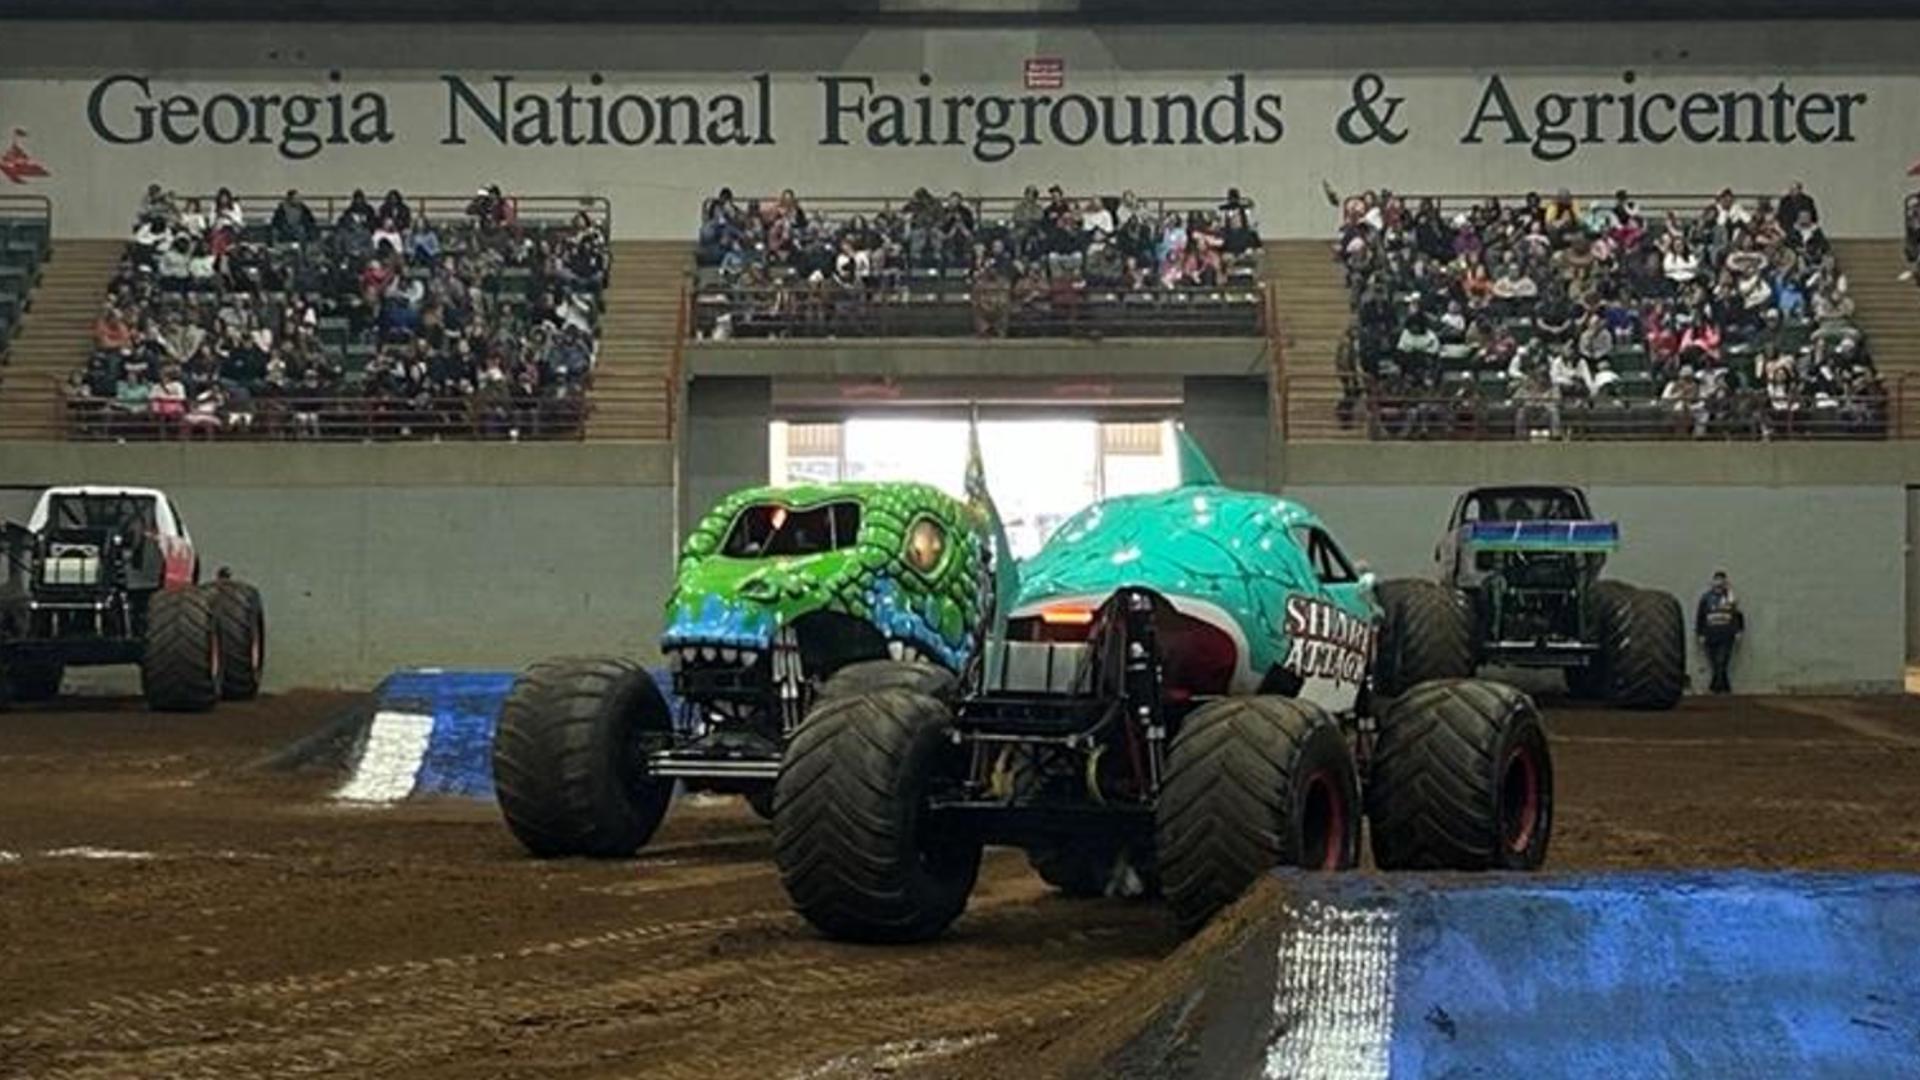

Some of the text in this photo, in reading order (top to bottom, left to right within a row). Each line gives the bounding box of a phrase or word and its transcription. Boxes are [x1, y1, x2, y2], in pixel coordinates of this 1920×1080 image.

[87, 70, 1868, 163] Georgia National Fairgrounds & Agricenter
